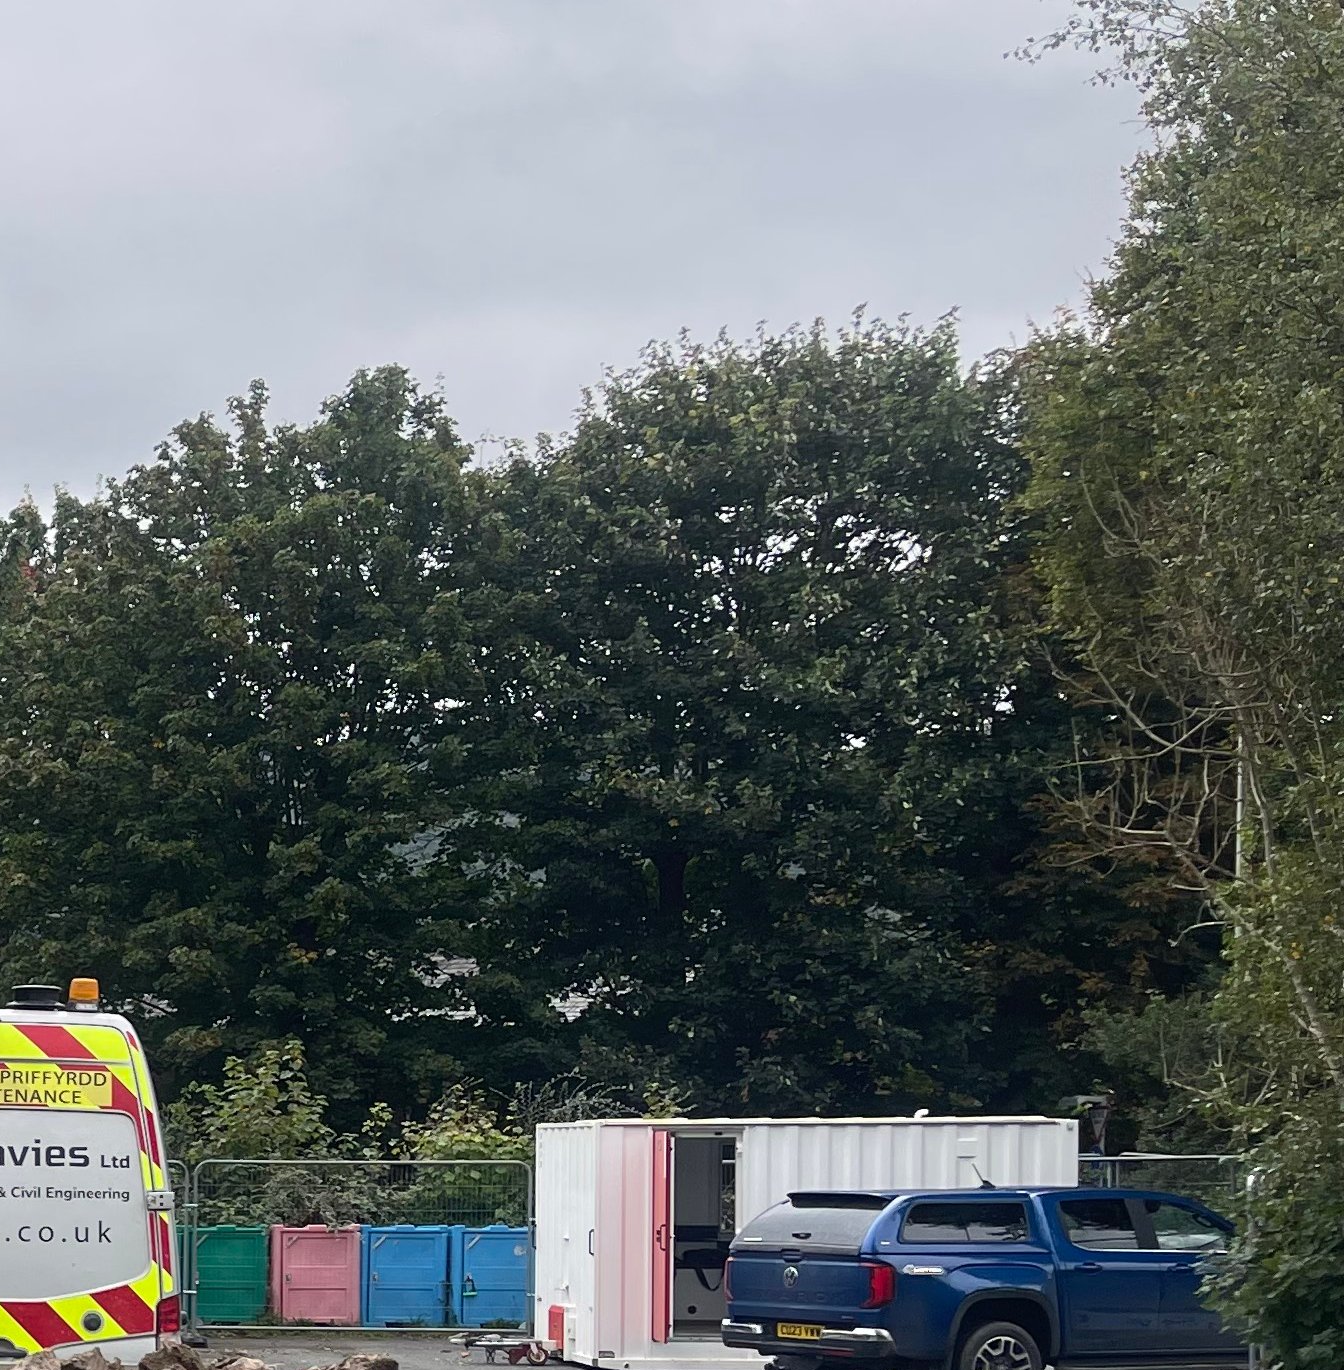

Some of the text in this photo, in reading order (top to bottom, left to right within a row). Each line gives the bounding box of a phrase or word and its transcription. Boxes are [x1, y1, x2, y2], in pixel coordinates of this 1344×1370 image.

[1, 1070, 107, 1087] PRIFFYRDD
[100, 1154, 131, 1169] Ltd
[11, 1186, 41, 1199] Civil
[46, 1187, 130, 1202] Engineering
